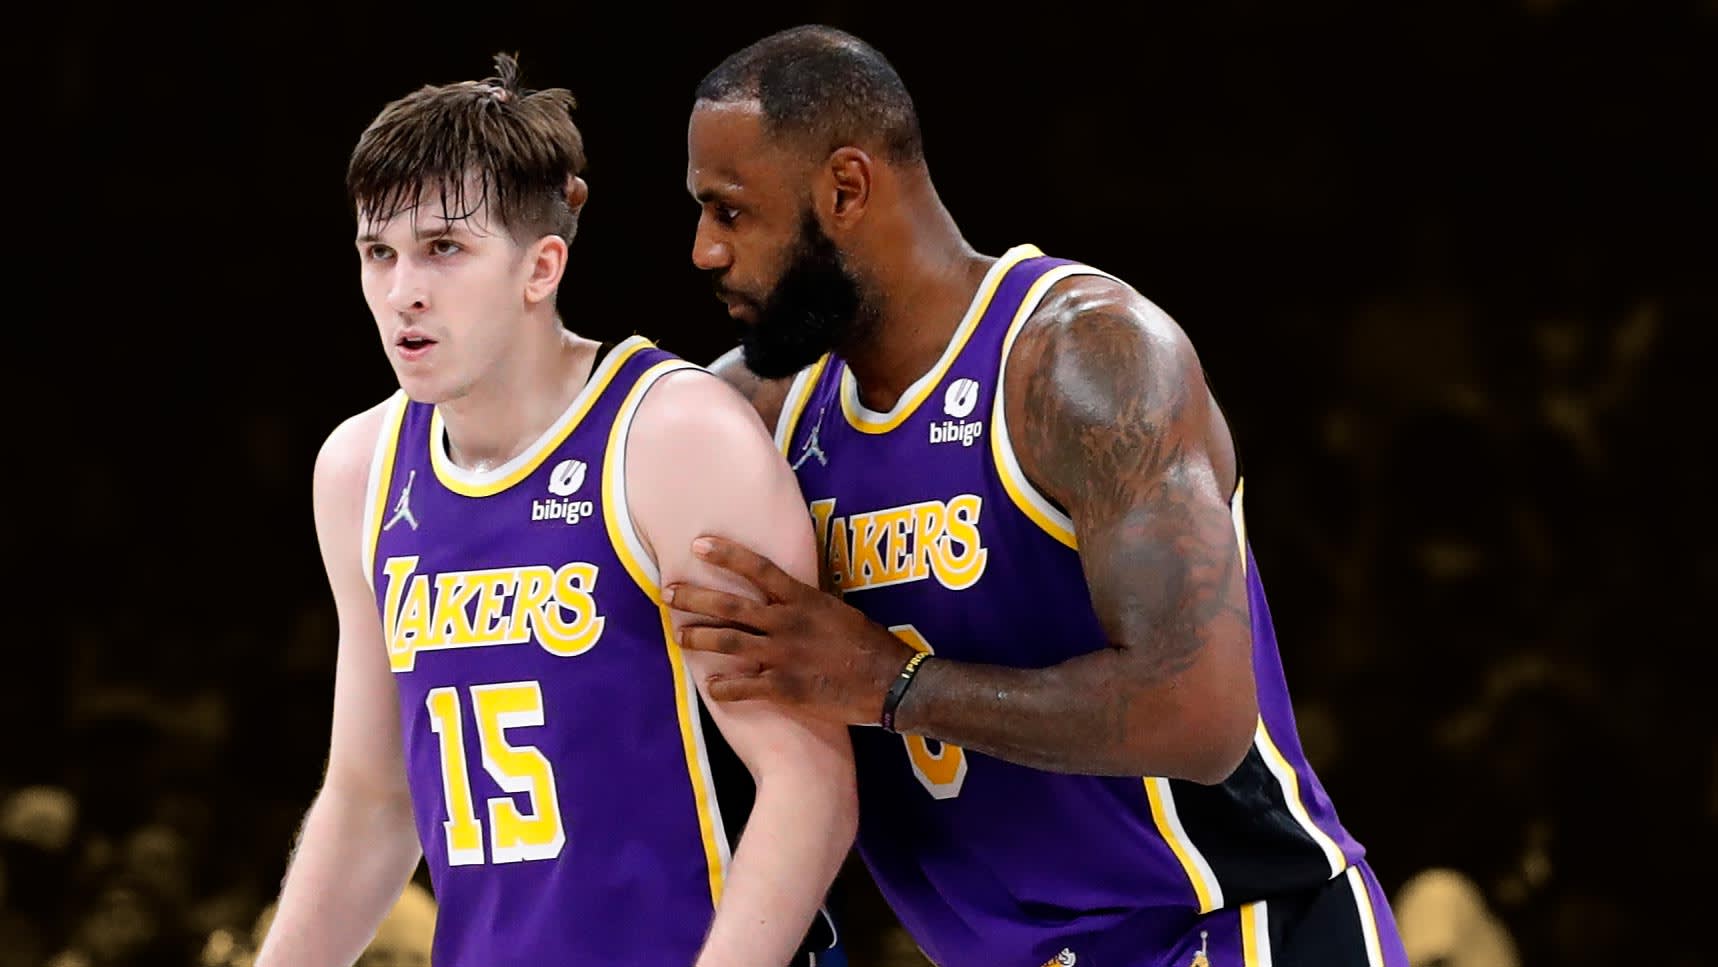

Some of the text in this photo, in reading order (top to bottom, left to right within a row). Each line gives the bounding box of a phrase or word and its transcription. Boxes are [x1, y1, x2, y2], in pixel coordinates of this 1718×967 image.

[929, 419, 983, 446] bibigo
[531, 497, 594, 525] bibigo
[811, 494, 988, 598] LAKERS
[382, 555, 606, 673] LAKERS
[426, 681, 566, 866] 15
